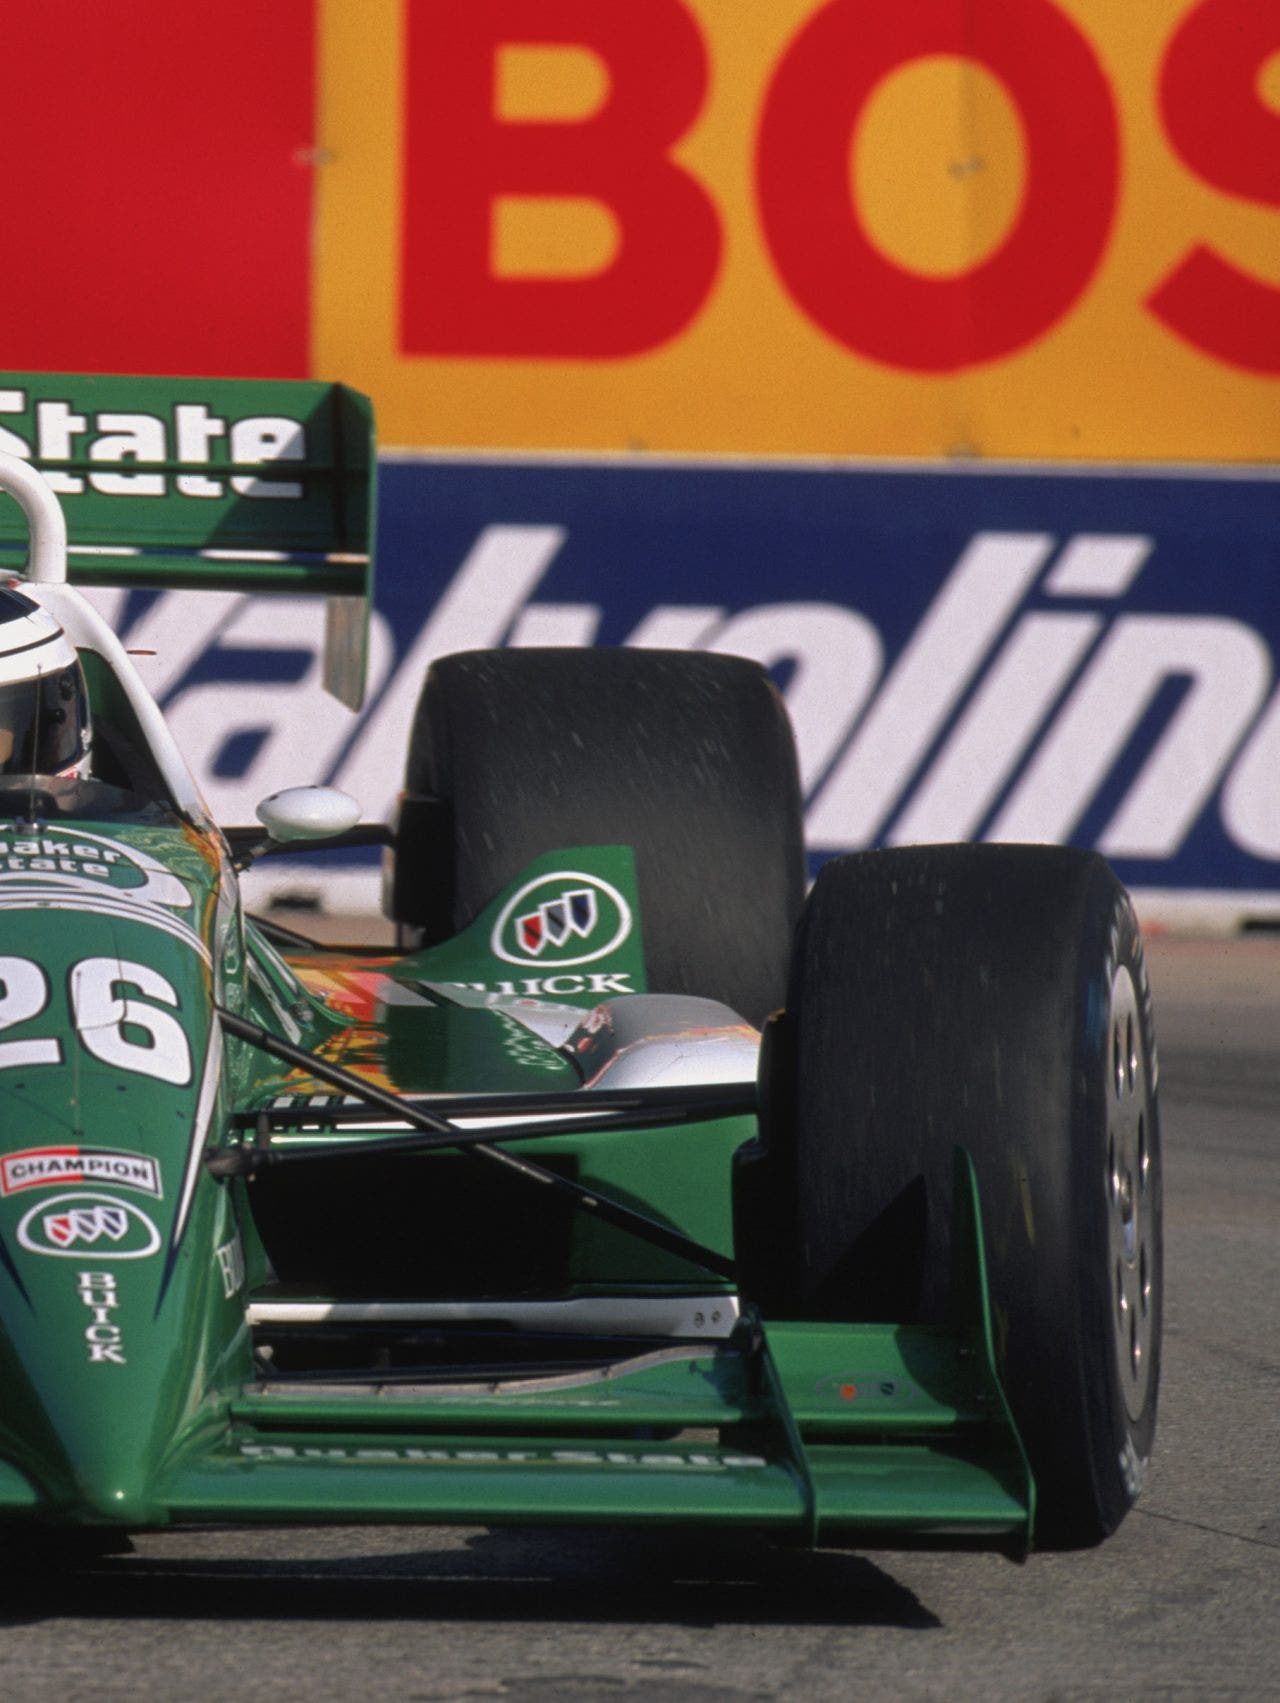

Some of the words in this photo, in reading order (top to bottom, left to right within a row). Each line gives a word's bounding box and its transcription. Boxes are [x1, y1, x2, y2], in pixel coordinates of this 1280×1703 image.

[450, 973, 636, 996] UICK
[11, 1158, 149, 1181] CHAMPION
[78, 1271, 126, 1364] BUICK
